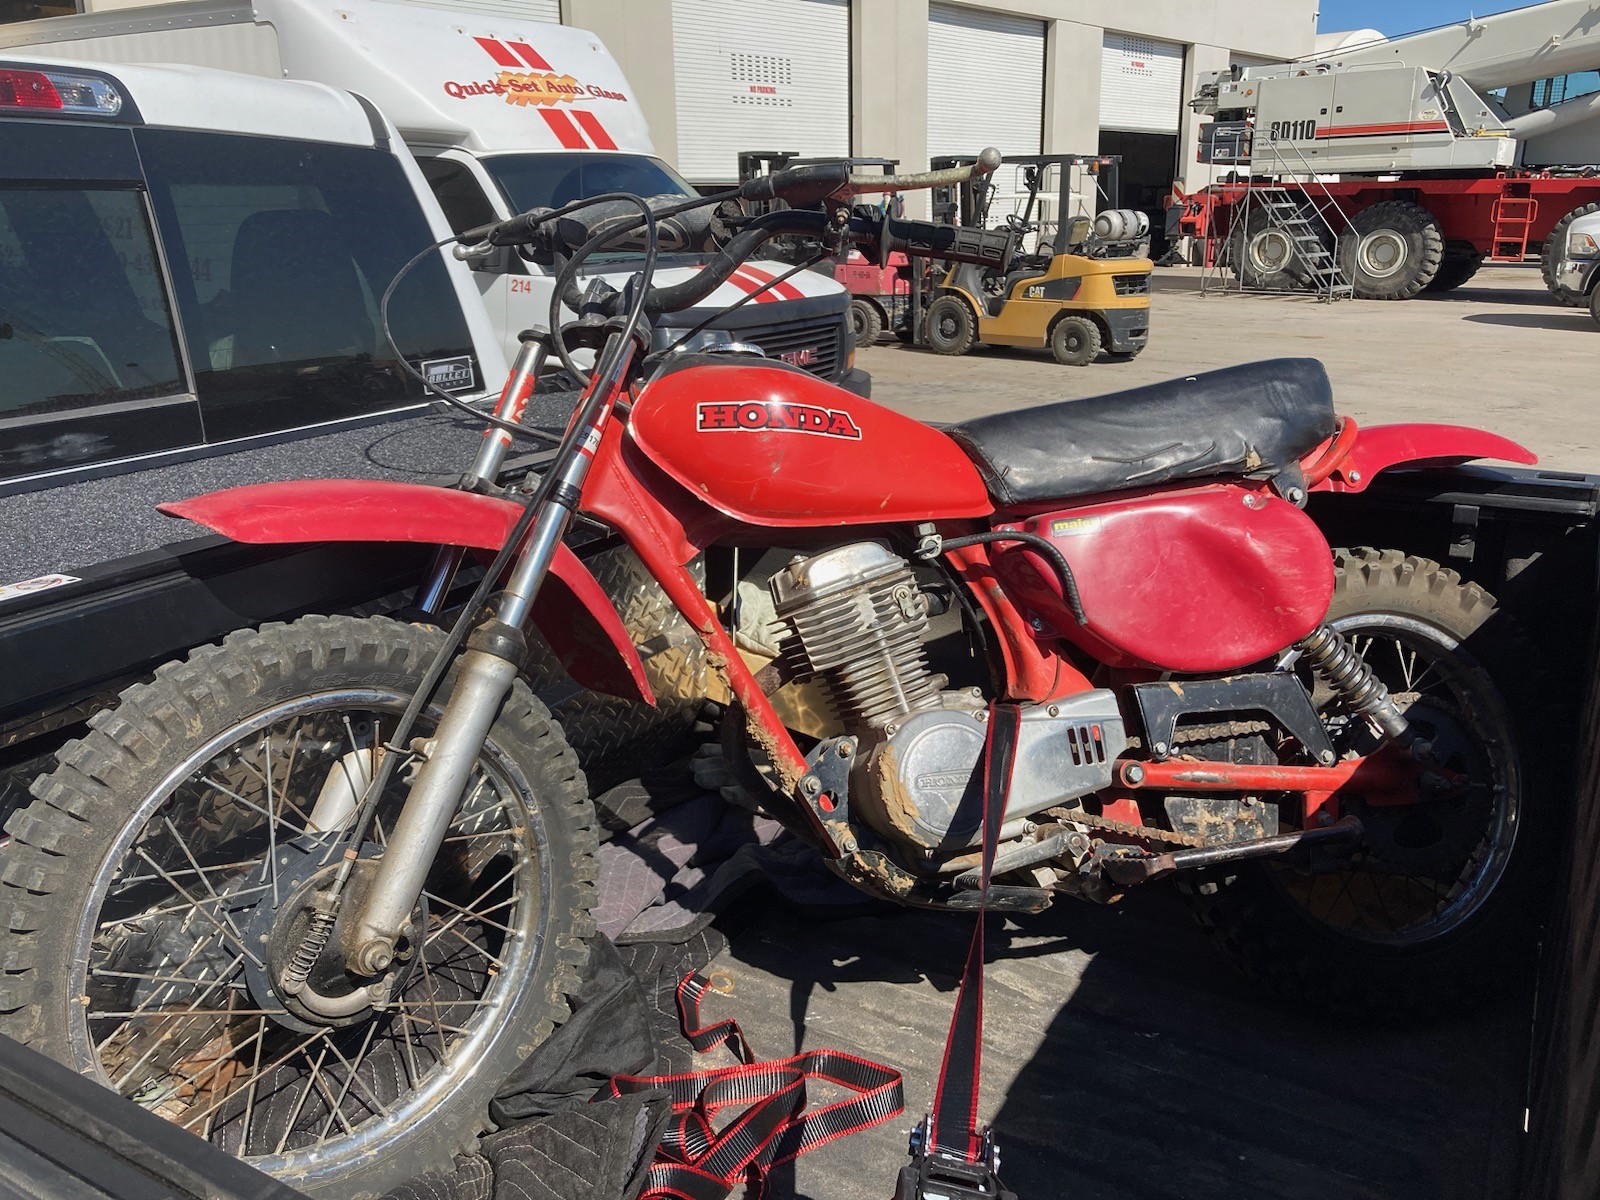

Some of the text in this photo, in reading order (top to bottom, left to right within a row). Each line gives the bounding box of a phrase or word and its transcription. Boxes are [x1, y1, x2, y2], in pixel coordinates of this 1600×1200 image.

[546, 80, 585, 95] Auto
[585, 84, 627, 102] Glass
[757, 86, 776, 94] PARKING
[1270, 120, 1316, 141] 80110
[511, 279, 531, 293] 214
[1029, 286, 1045, 298] CAT
[697, 401, 861, 440] HONDA
[919, 773, 970, 788] HOND
